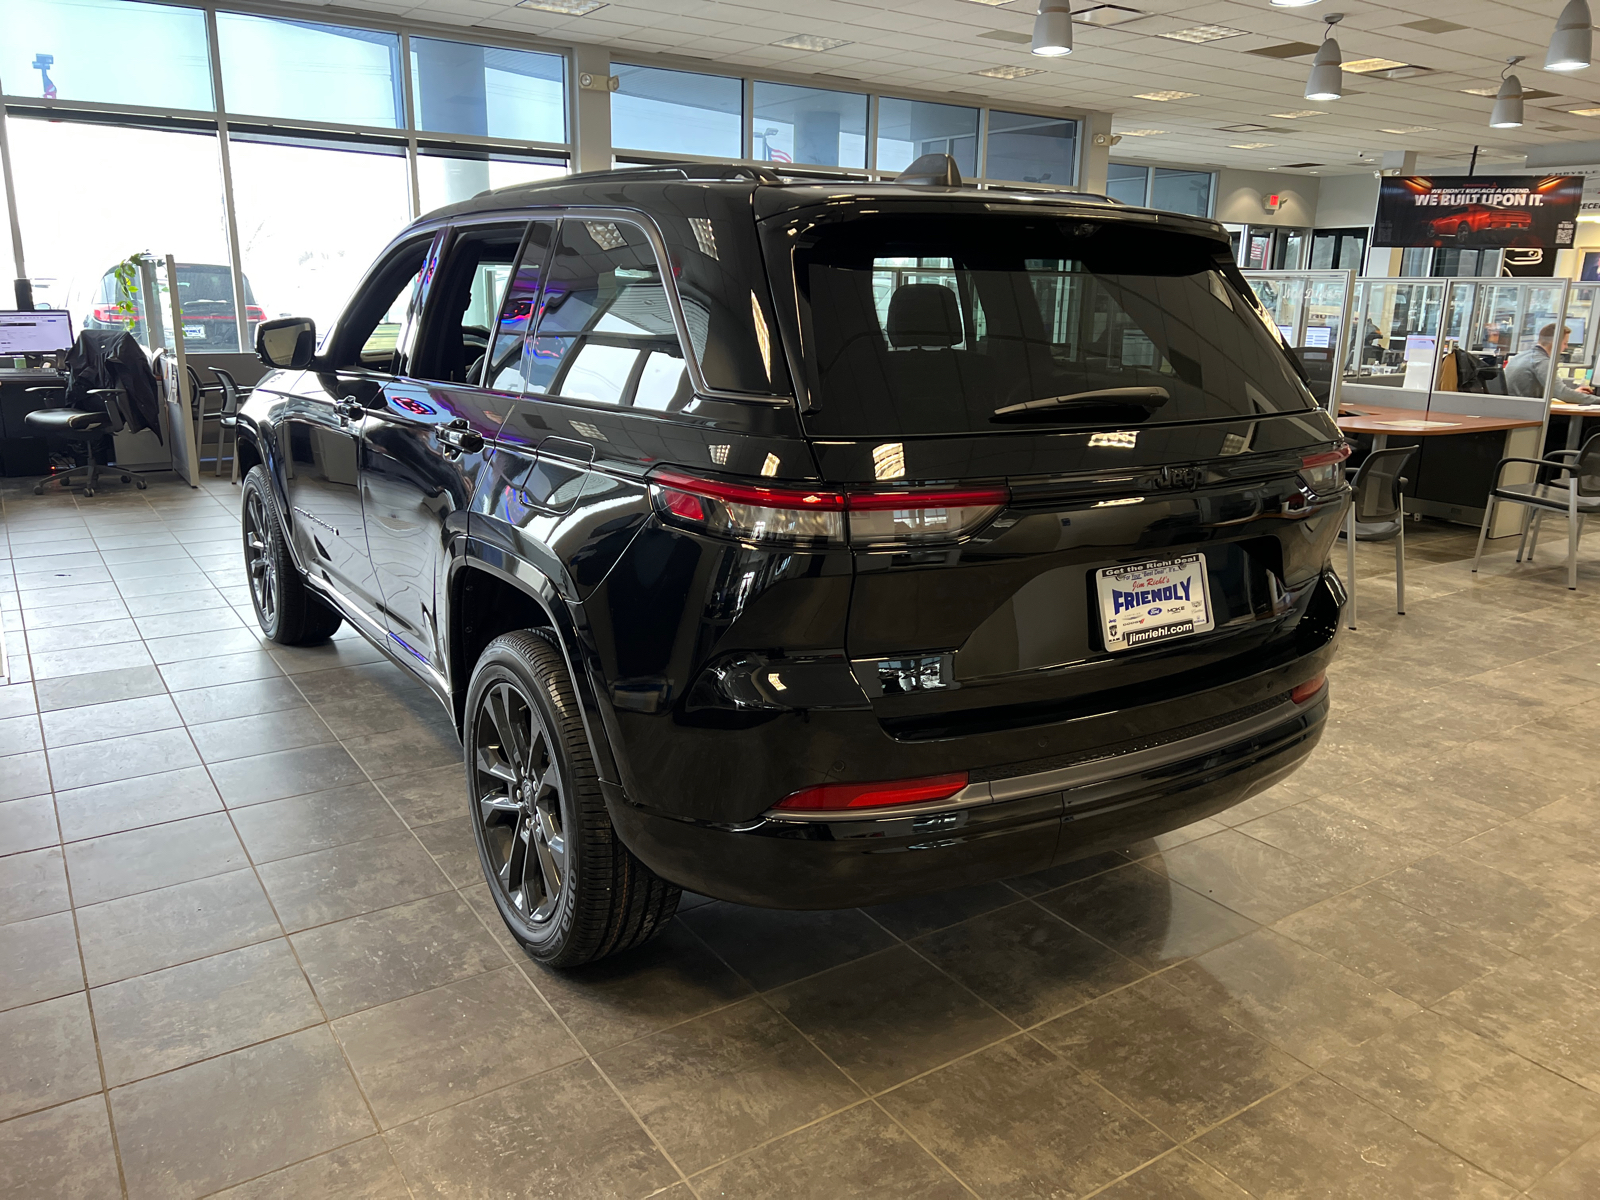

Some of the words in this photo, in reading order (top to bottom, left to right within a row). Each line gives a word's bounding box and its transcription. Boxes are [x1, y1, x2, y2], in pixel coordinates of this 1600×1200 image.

[1414, 194, 1438, 206] WE
[1440, 194, 1480, 206] BUILT
[1481, 194, 1527, 206] UPON
[1528, 194, 1544, 206] IT.
[1155, 465, 1205, 492] Jeep
[1106, 567, 1124, 576] Get
[1127, 564, 1144, 573] the
[1146, 561, 1171, 569] Riehl
[1175, 556, 1196, 565] Deal
[1132, 581, 1145, 592] Jim
[1146, 576, 1170, 587] Riehl's
[1111, 575, 1192, 616] FRIENDLY
[1129, 622, 1193, 645] jimriehl.com
